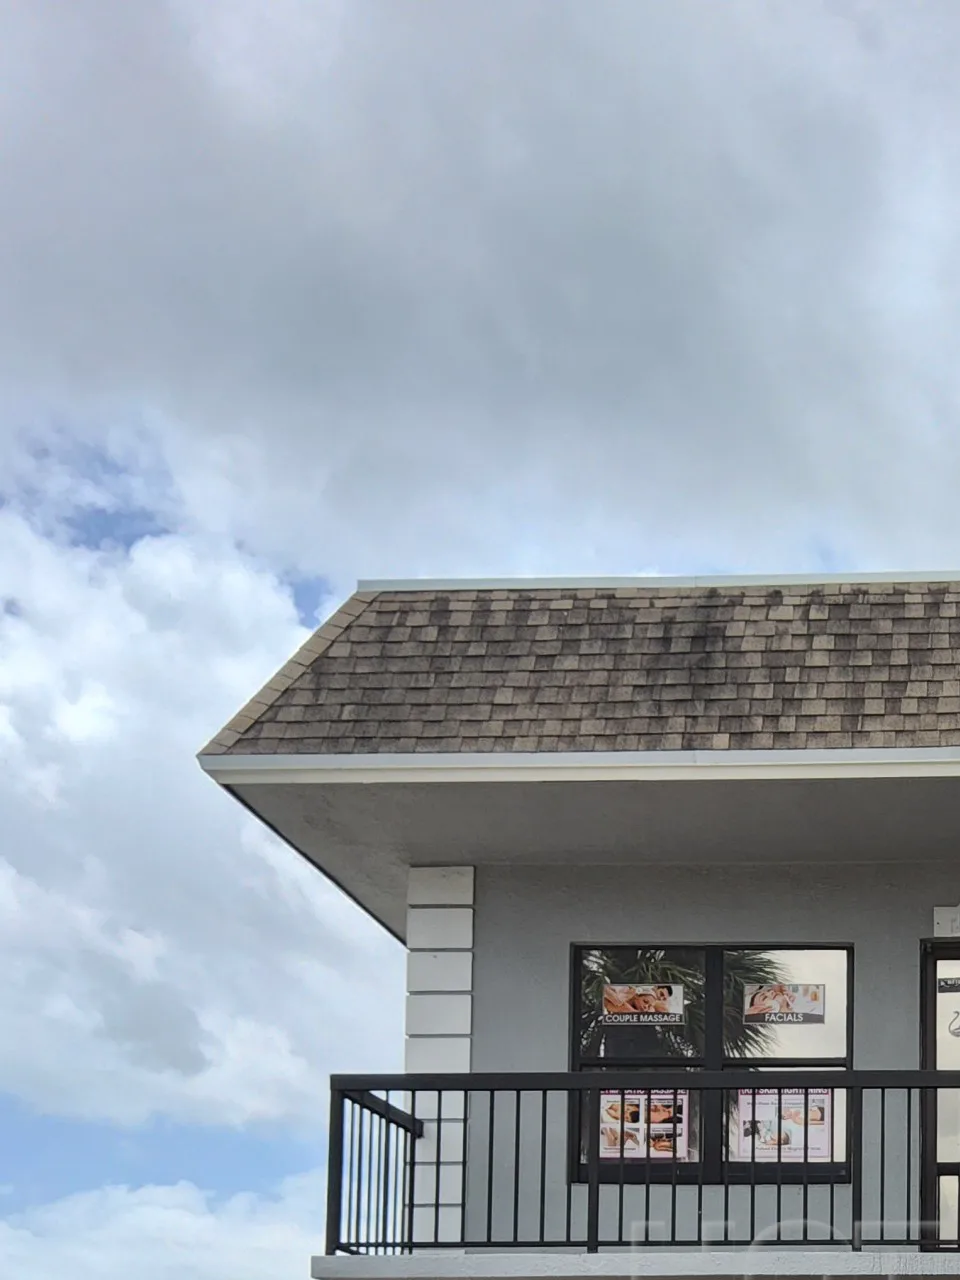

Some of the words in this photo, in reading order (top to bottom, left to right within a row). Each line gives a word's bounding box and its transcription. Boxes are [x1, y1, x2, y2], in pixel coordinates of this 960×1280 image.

[605, 1014, 638, 1023] COUPLE
[640, 1014, 681, 1022] MASSAGE
[764, 1013, 804, 1022] FACIALS
